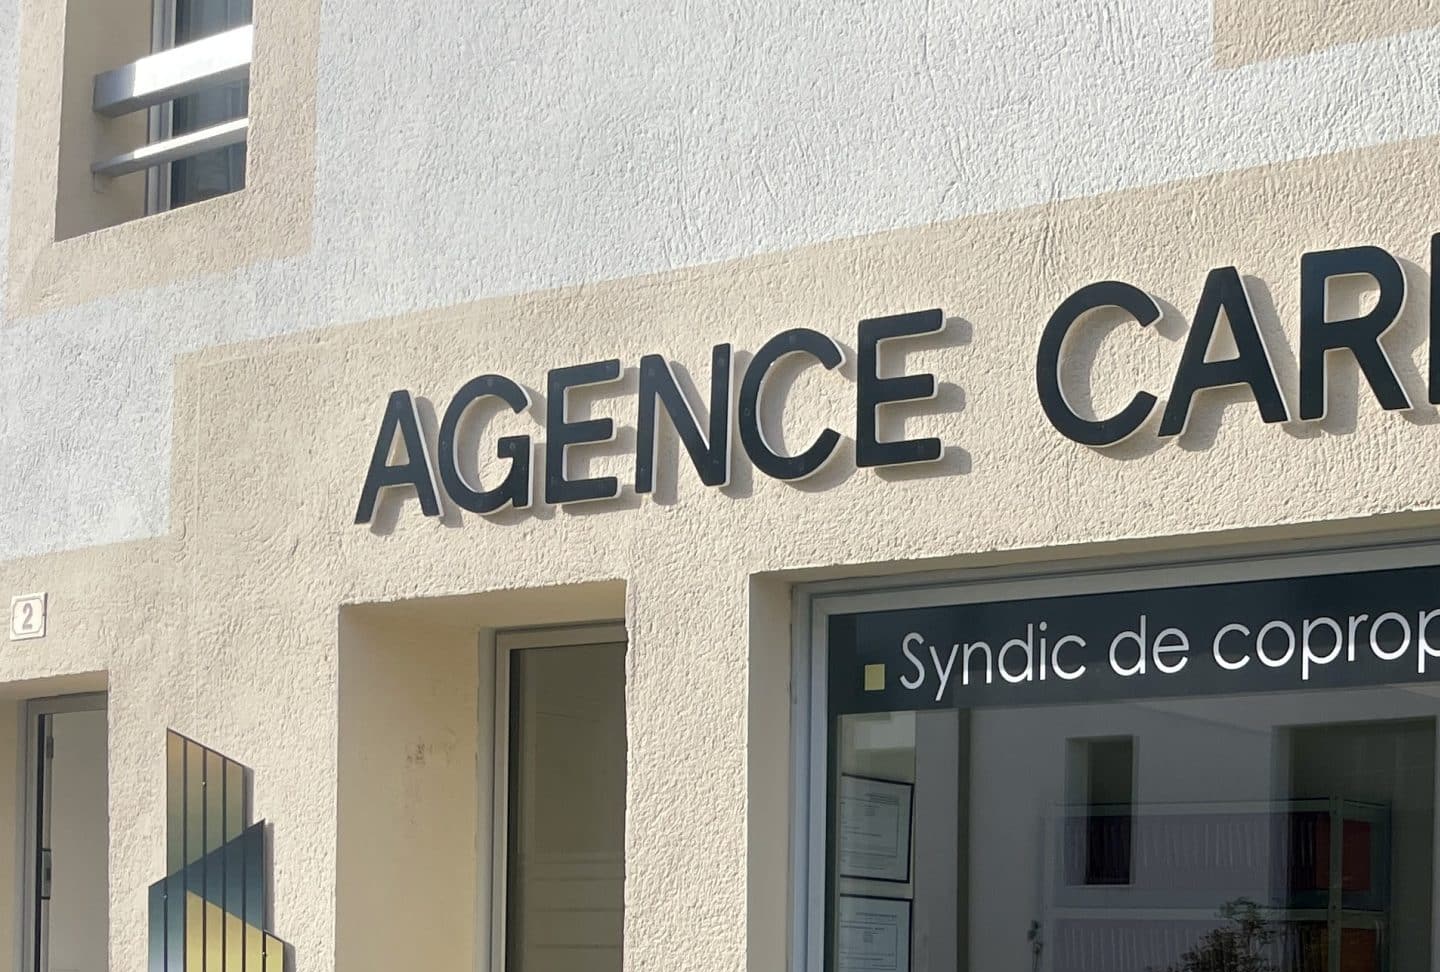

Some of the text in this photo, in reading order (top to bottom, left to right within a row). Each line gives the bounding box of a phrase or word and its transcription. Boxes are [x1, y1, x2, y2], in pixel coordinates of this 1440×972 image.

[354, 308, 945, 525] AGENCE
[22, 602, 34, 630] 2
[899, 621, 1087, 702] Syndic
[1109, 614, 1190, 677] de
